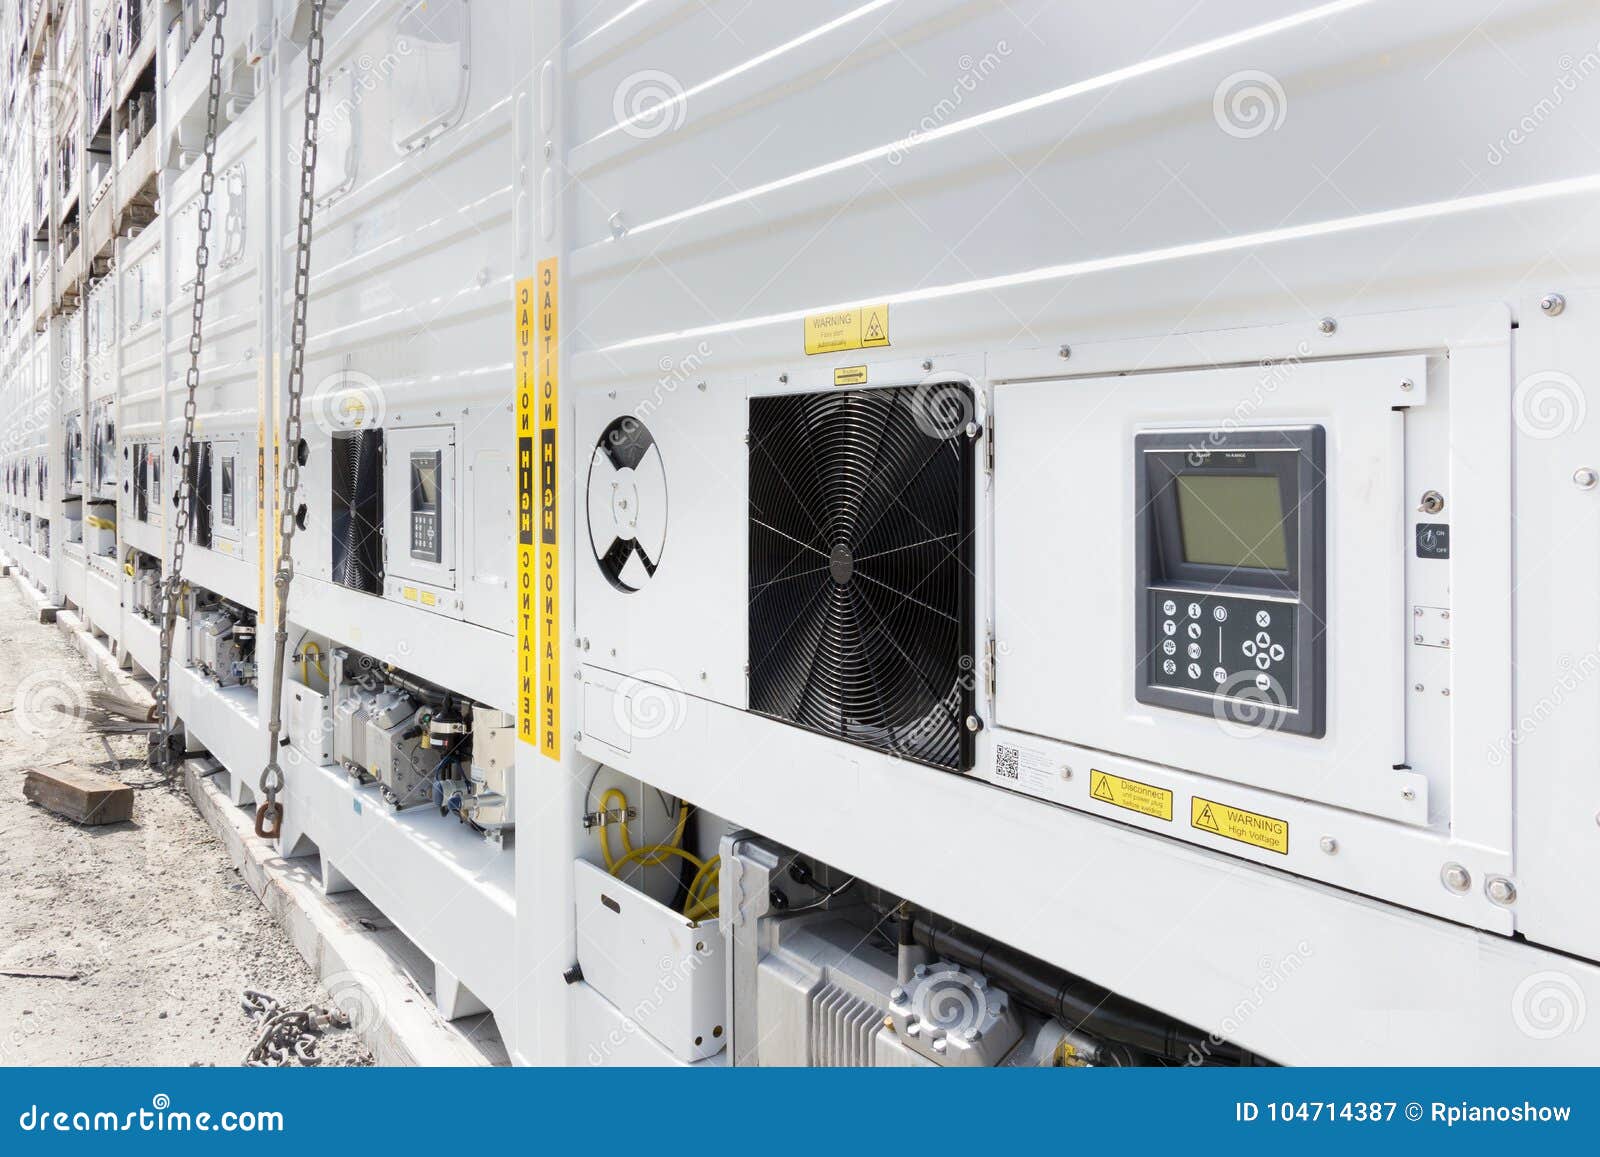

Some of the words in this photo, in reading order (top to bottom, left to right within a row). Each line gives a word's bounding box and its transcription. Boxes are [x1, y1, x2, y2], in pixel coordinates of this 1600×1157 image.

[813, 312, 852, 329] WARNING
[1121, 780, 1164, 801] Disconnect
[1227, 810, 1283, 835] WARNING
[1228, 825, 1247, 836] High
[1249, 831, 1280, 846] Voltage
